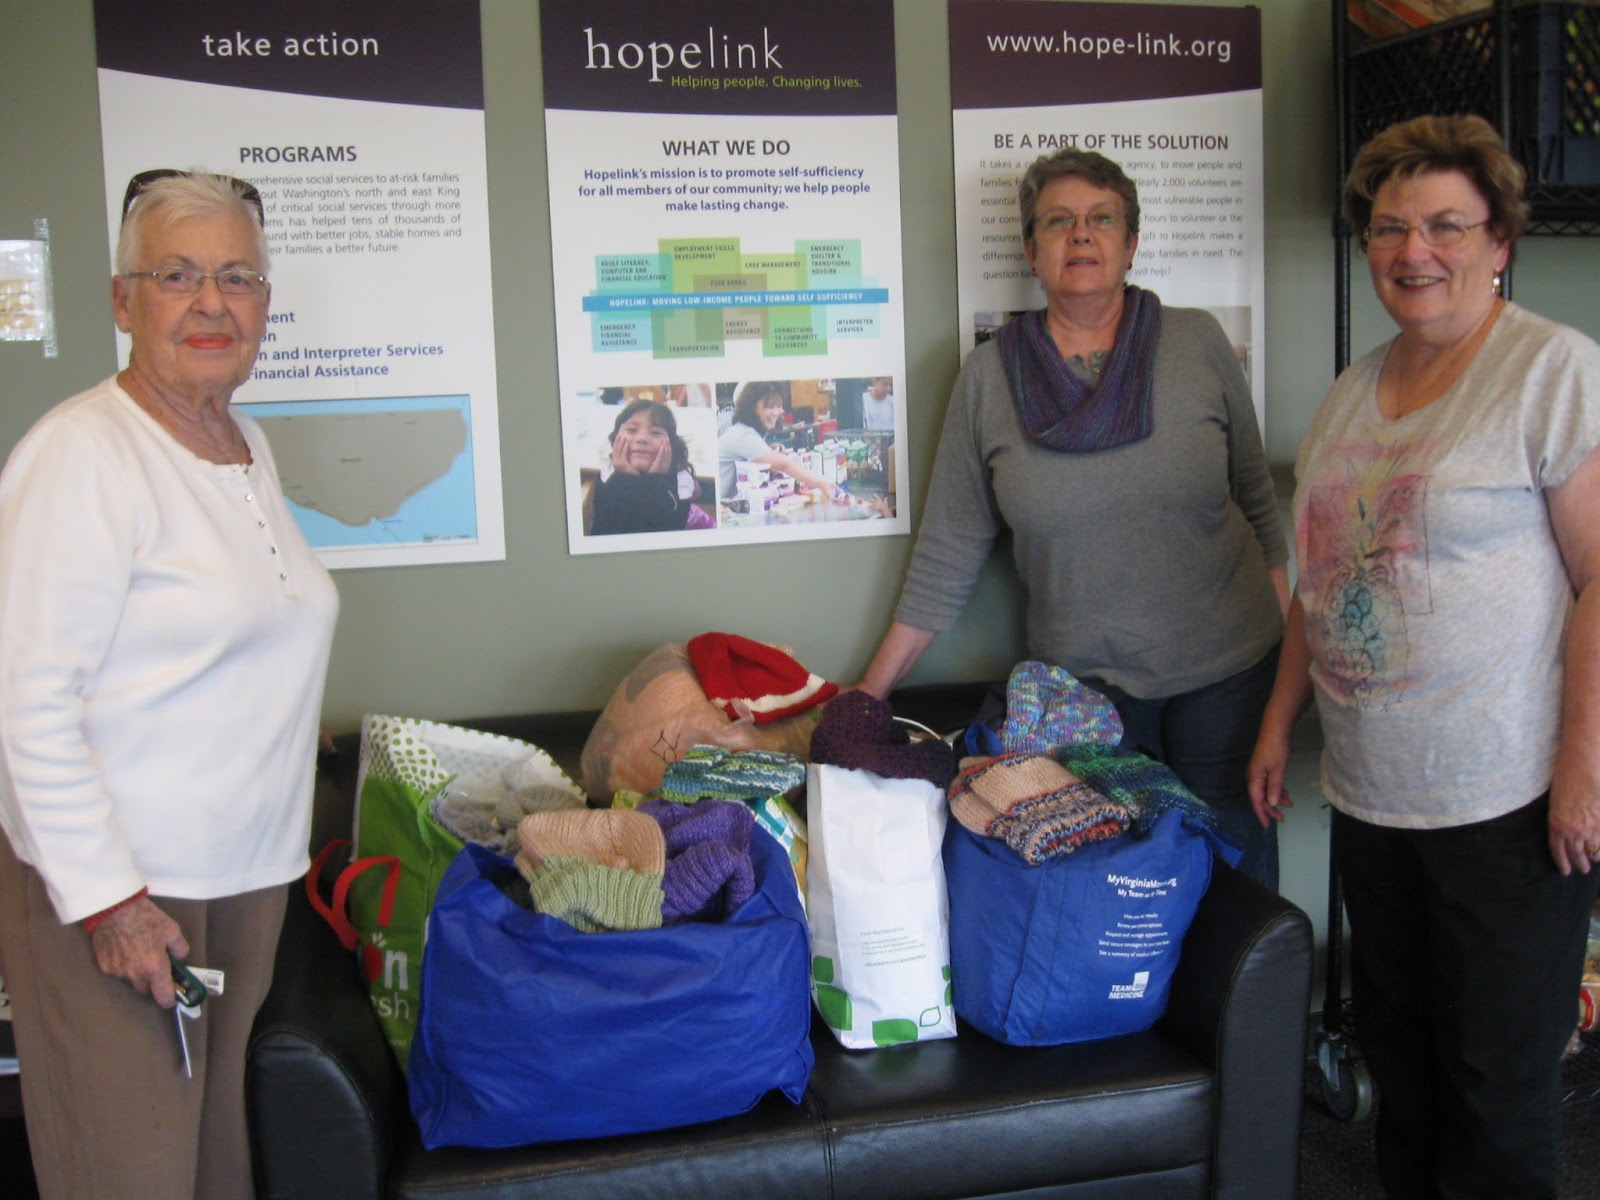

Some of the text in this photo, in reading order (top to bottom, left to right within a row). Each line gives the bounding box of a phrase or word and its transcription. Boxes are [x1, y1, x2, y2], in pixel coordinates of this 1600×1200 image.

[202, 32, 379, 57] take action
[987, 30, 1232, 63] www.hope-link.org
[583, 26, 783, 82] hopelink
[672, 76, 862, 89] Helping people. Changing lives.
[994, 133, 1228, 150] BE A PART OF THE SOLUTION
[240, 146, 357, 163] PROGRAMS
[662, 140, 791, 157] WHAT WE DO
[990, 160, 1012, 168] takes
[1198, 160, 1224, 170] people
[306, 174, 334, 184] social
[336, 174, 374, 184] services
[376, 174, 386, 184] to
[390, 174, 419, 183] at-risk
[422, 172, 460, 182] families
[584, 166, 864, 184] Hopelink's mission is to promote self-sufficiency
[981, 178, 1012, 187] families
[1162, 178, 1186, 188] 2,000
[1188, 178, 1228, 187] volunteers
[283, 188, 350, 200] Washington's
[356, 188, 382, 198] north
[388, 187, 406, 196] and
[412, 187, 432, 196] east
[438, 186, 460, 198] King
[578, 182, 870, 198] for all members of our community; we help people
[266, 200, 460, 212] of critical social services through more
[666, 198, 788, 213] make lasting change.
[981, 197, 1016, 206] essential
[1142, 196, 1232, 206] most vulnerable people
[289, 218, 306, 226] has
[312, 216, 346, 228] helped
[352, 216, 372, 225] tens
[378, 215, 388, 224] of
[394, 214, 445, 224] thousands
[450, 214, 461, 223] of
[982, 216, 996, 224] our
[1144, 214, 1167, 222] hours
[1180, 214, 1216, 222] volunteer
[1230, 214, 1242, 222] the
[291, 230, 312, 240] with
[316, 230, 346, 240] better
[349, 230, 372, 240] jobs,
[376, 228, 404, 238] stable
[408, 228, 440, 238] homes
[444, 228, 462, 237] and
[1142, 232, 1234, 242] gift Hopelink makes
[286, 244, 323, 254] families
[336, 244, 364, 253] better
[1138, 250, 1154, 259] help
[1160, 249, 1188, 258] families
[983, 270, 1018, 280] question
[652, 298, 682, 306] MOVING
[684, 296, 732, 304] LOW-INCOME
[735, 295, 761, 304] PEOPLE
[765, 294, 794, 302] TOWARD
[800, 294, 814, 302] SELF
[816, 292, 863, 301] SUFFICIENCY
[273, 348, 300, 361] and
[304, 346, 382, 362] Interpreter
[386, 344, 444, 356] Services
[315, 364, 389, 377] Assistance
[1108, 990, 1144, 999] MEDICINE
